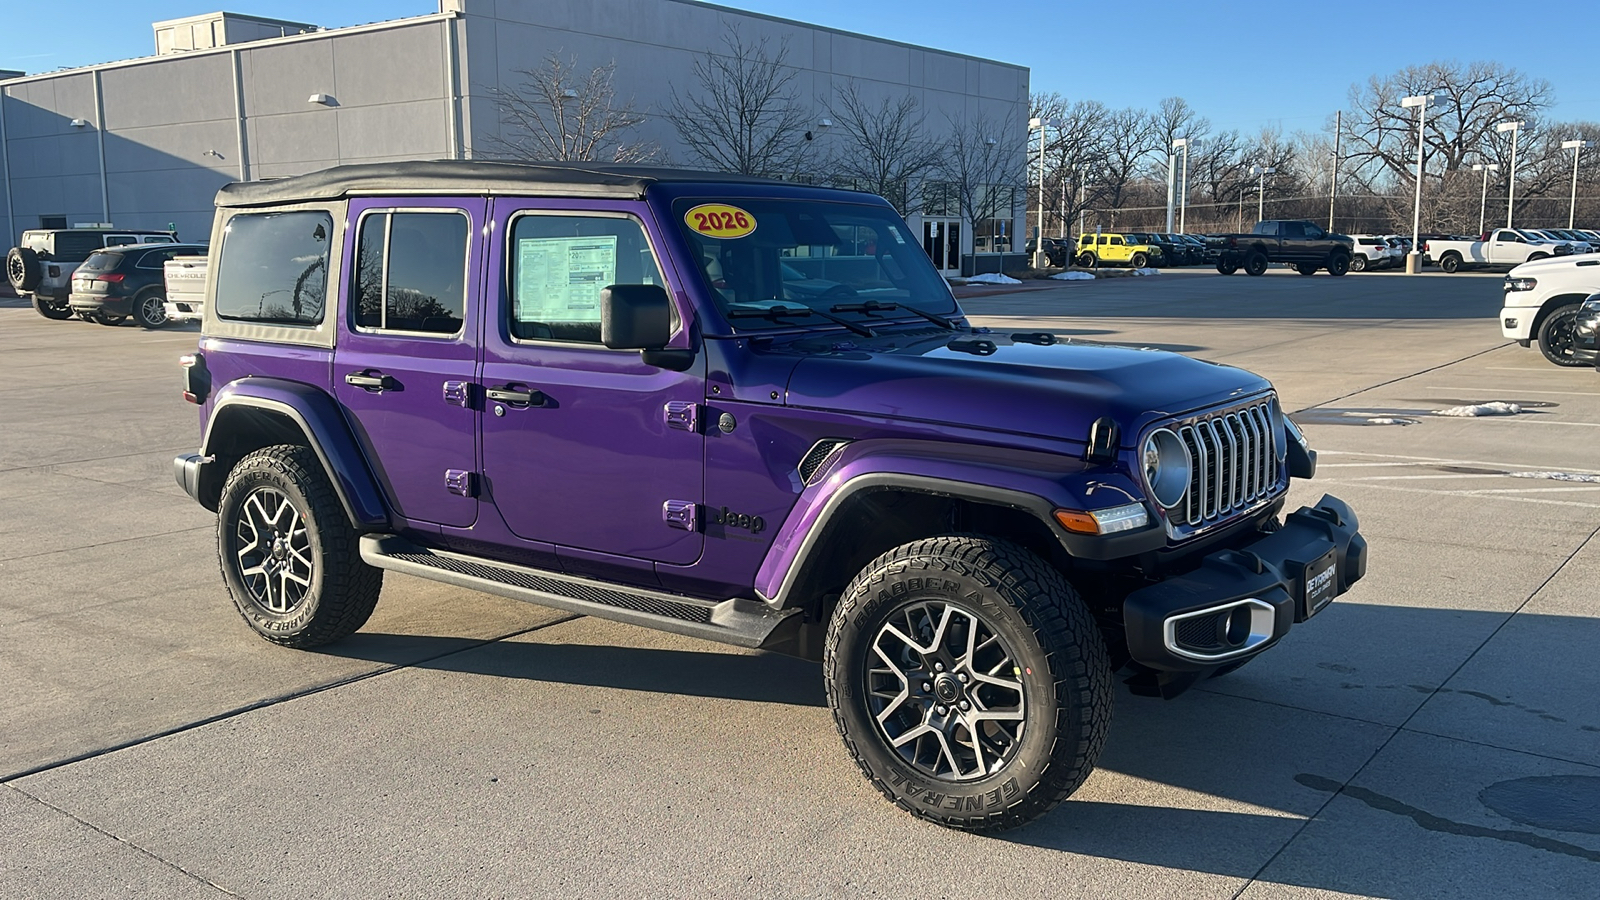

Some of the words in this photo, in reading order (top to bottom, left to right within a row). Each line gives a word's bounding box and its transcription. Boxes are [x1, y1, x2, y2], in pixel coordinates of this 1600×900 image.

[694, 211, 750, 231] 2026
[230, 471, 290, 499] GENERAL
[715, 505, 764, 535] Jeep
[263, 592, 317, 631] GRABBER
[853, 577, 961, 631] GRABBER
[964, 590, 1012, 621] A/T
[888, 767, 1020, 812] GENERAL
